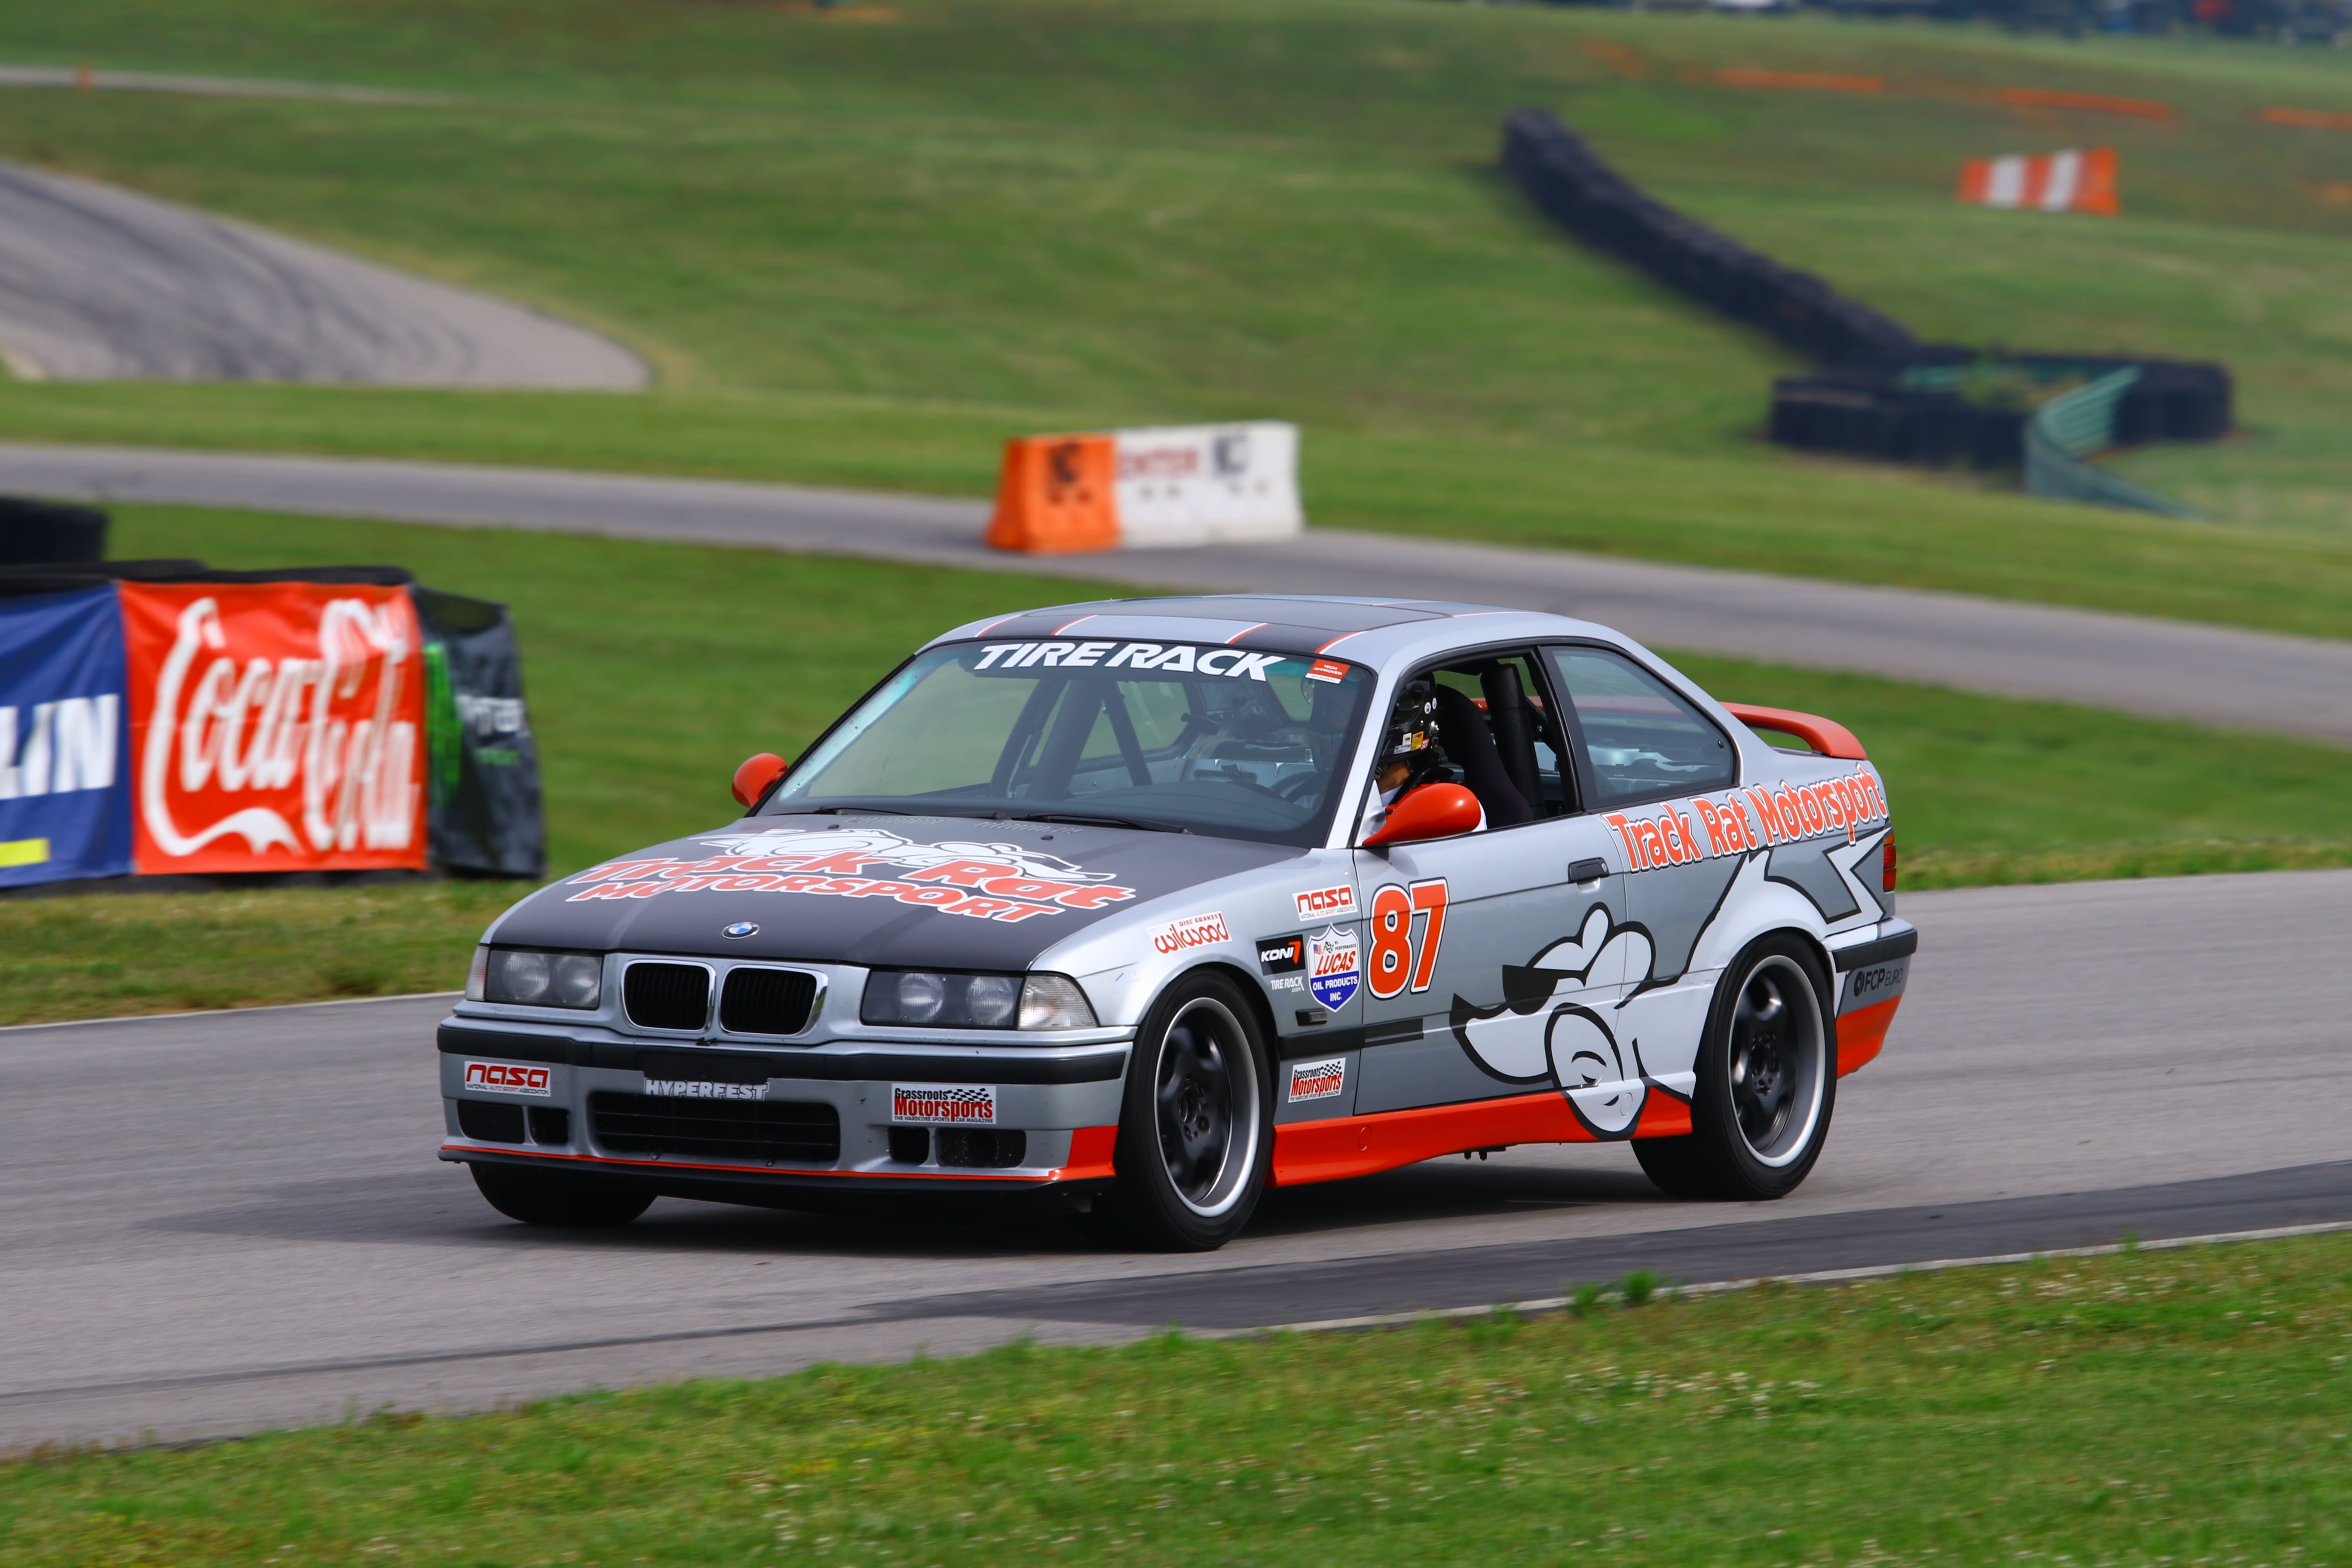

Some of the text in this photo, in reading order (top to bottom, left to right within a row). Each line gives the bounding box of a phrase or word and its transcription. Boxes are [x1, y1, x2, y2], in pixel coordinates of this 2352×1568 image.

[974, 642, 1287, 682] TIRE RACK
[1313, 667, 1343, 676] APPROVED
[1600, 762, 1889, 873] Track Rat Motorsport
[898, 859, 1136, 910] Rat
[565, 874, 1066, 923] MOTORSPORT
[1297, 887, 1353, 913] nasa
[1194, 914, 1218, 923] BRAKES
[1155, 913, 1228, 954] wilwood
[1366, 876, 1450, 1001] 87
[1261, 946, 1294, 962] KONI
[1315, 950, 1356, 976] LUCAS
[1271, 976, 1305, 991] TIRE RACK
[1313, 975, 1358, 991] OIL PRODUCTS
[1864, 968, 1885, 992] FCP
[466, 1064, 549, 1088] nasa
[1291, 1073, 1342, 1097] Motorsports
[1294, 1067, 1321, 1080] Grassroots
[645, 1078, 768, 1101] HYPERFEST
[894, 1088, 948, 1100] Grassroots
[894, 1096, 993, 1121] Motorsports
